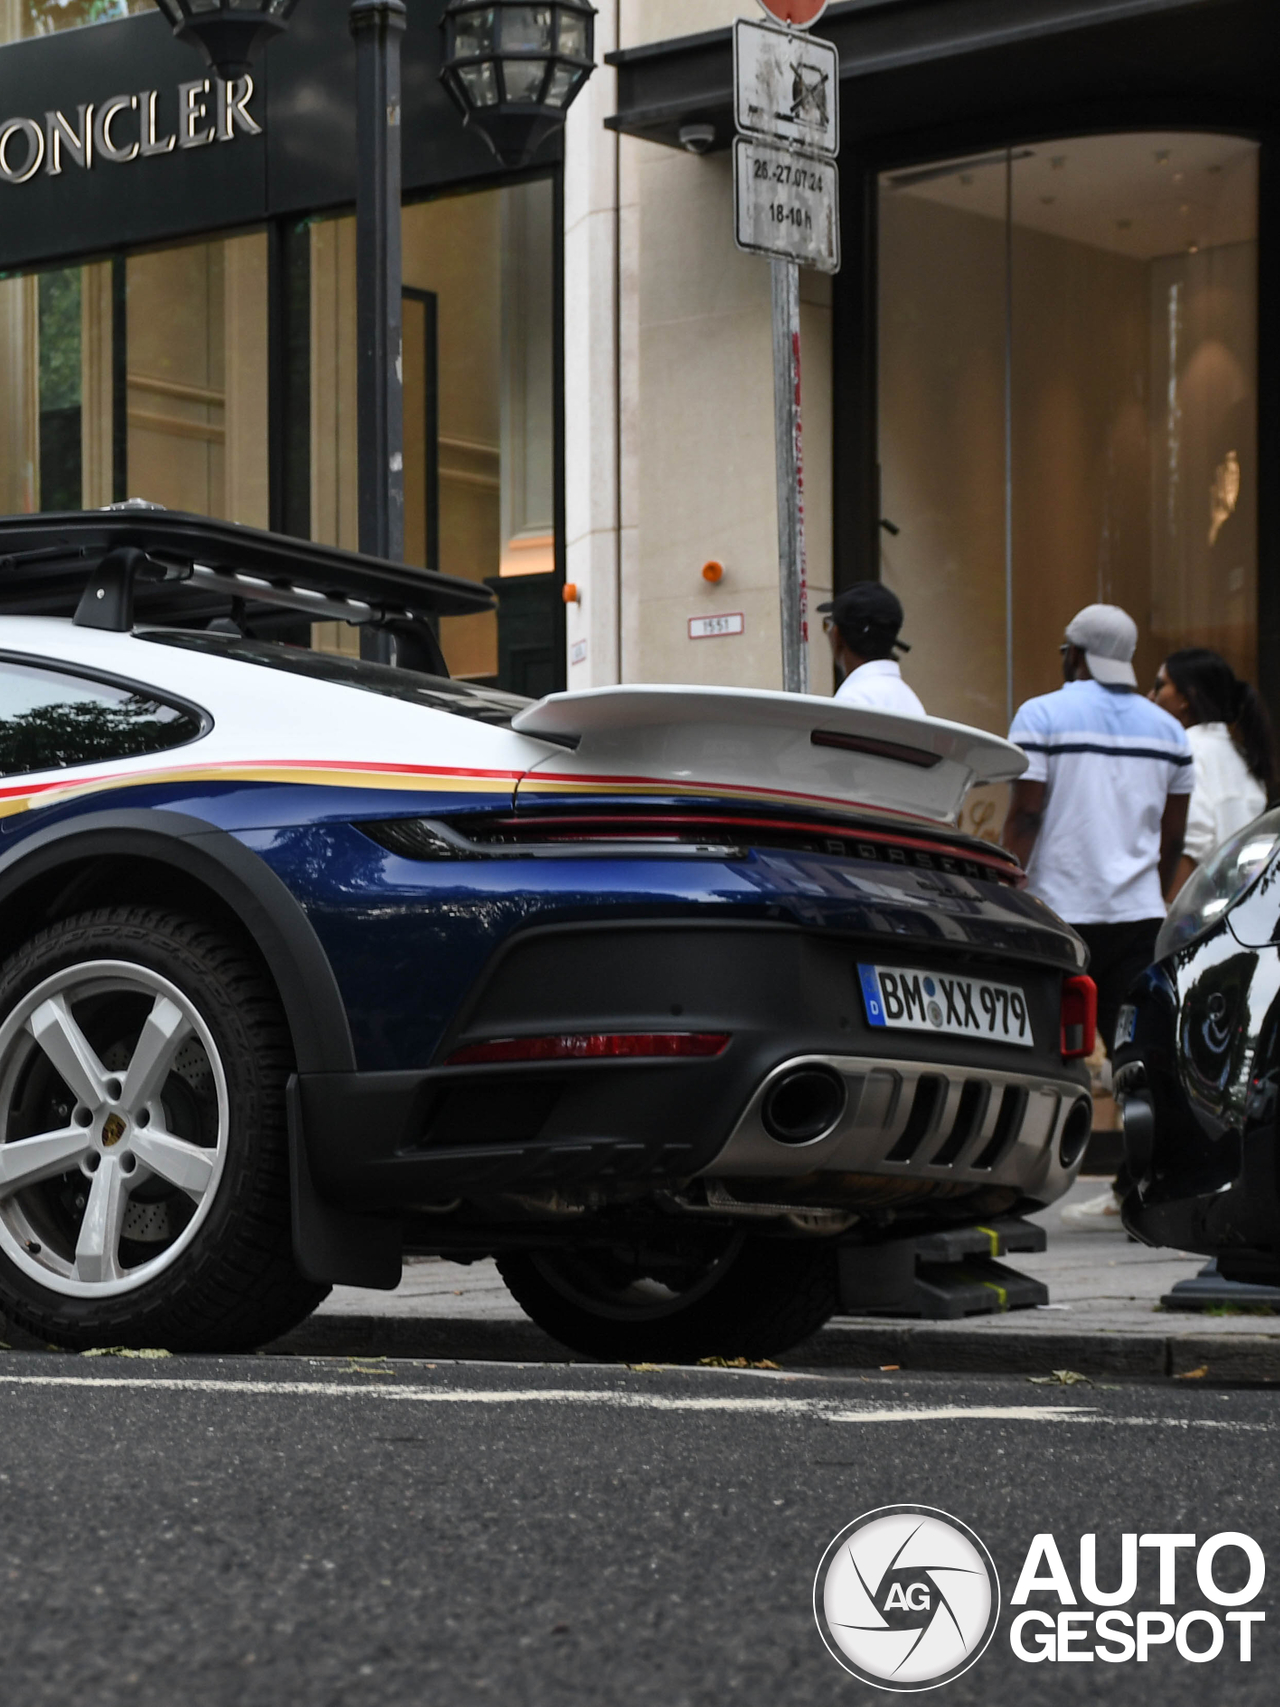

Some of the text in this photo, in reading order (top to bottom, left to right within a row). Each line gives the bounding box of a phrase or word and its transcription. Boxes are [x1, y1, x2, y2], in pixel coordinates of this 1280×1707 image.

[870, 972, 1027, 1038] D BM XX 979
